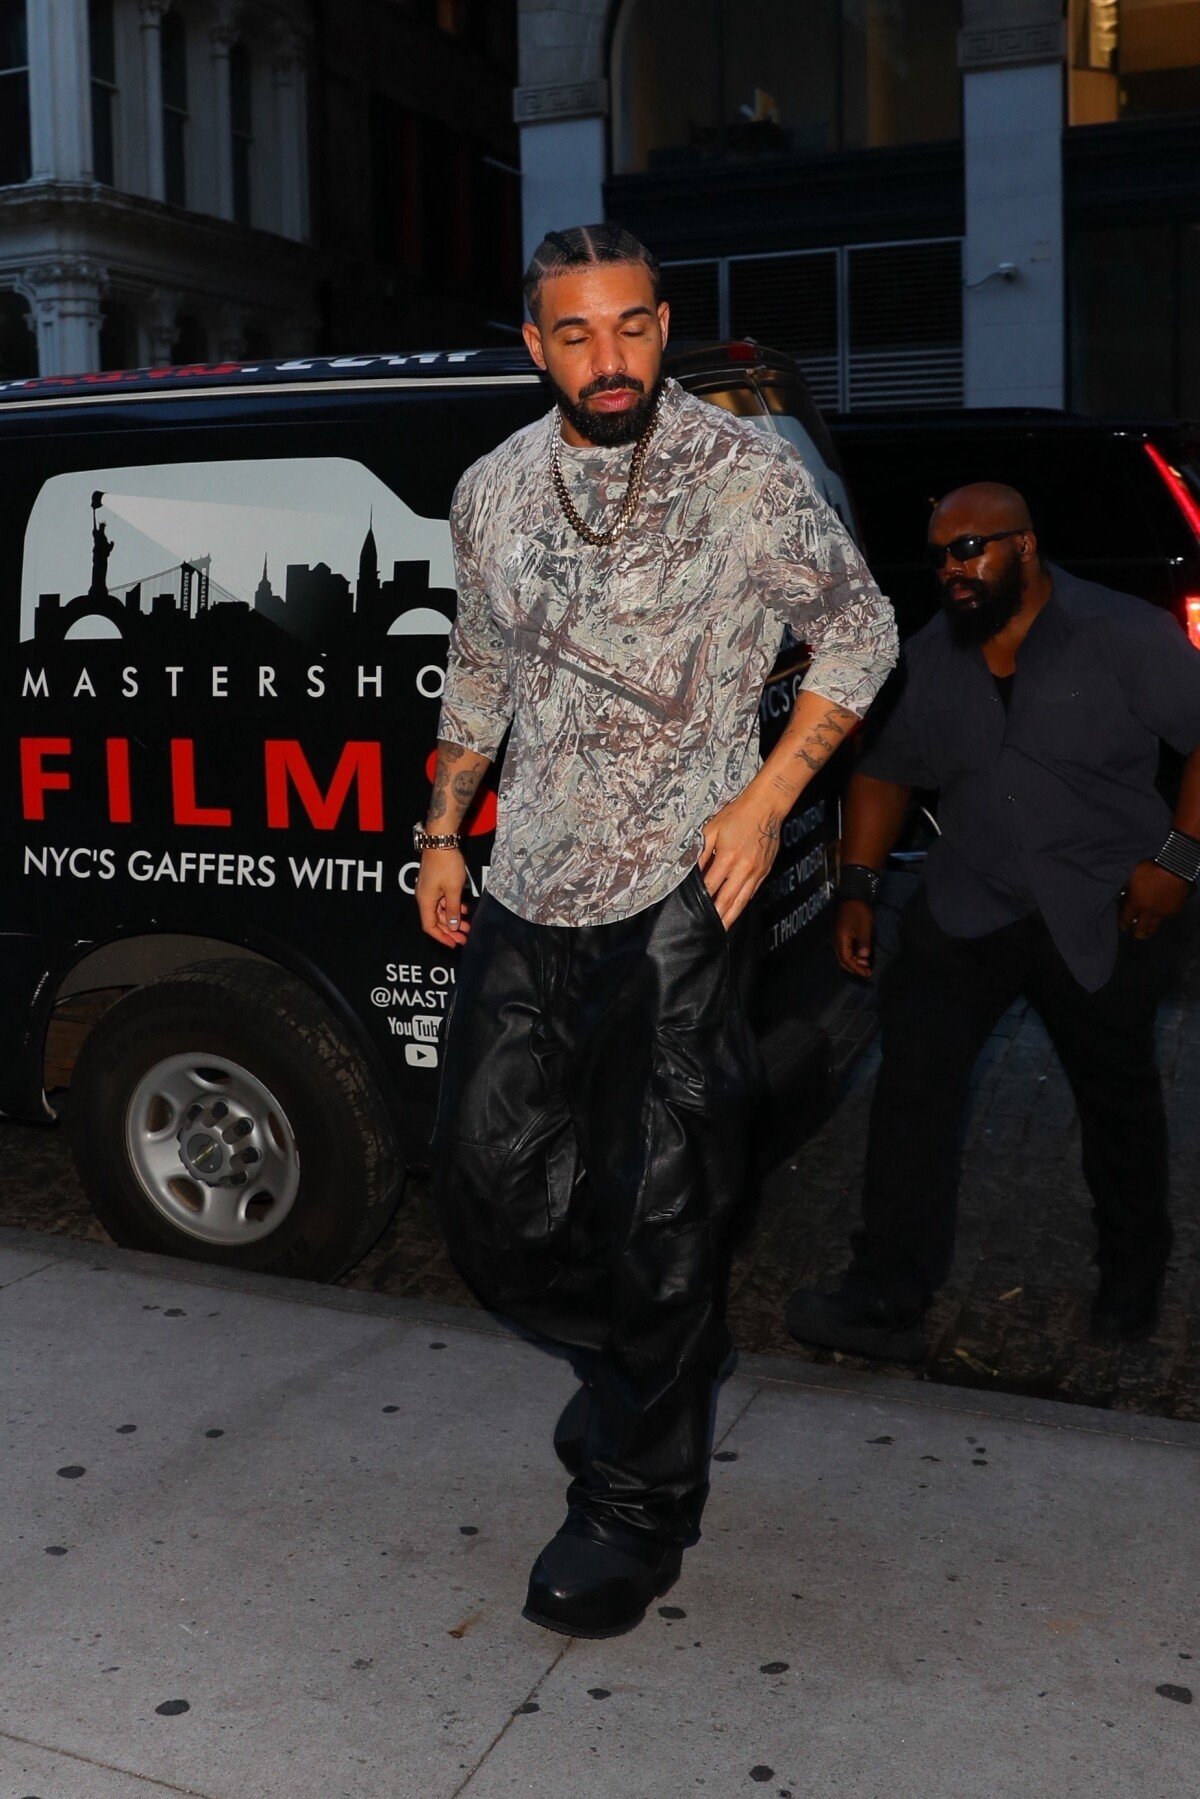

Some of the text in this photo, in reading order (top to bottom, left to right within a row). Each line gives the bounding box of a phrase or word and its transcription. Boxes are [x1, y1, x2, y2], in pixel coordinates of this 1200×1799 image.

[24, 845, 116, 880] NYC'S
[127, 850, 276, 888] GAFFERS
[288, 857, 383, 893] WITH
[386, 963, 423, 983] SEE
